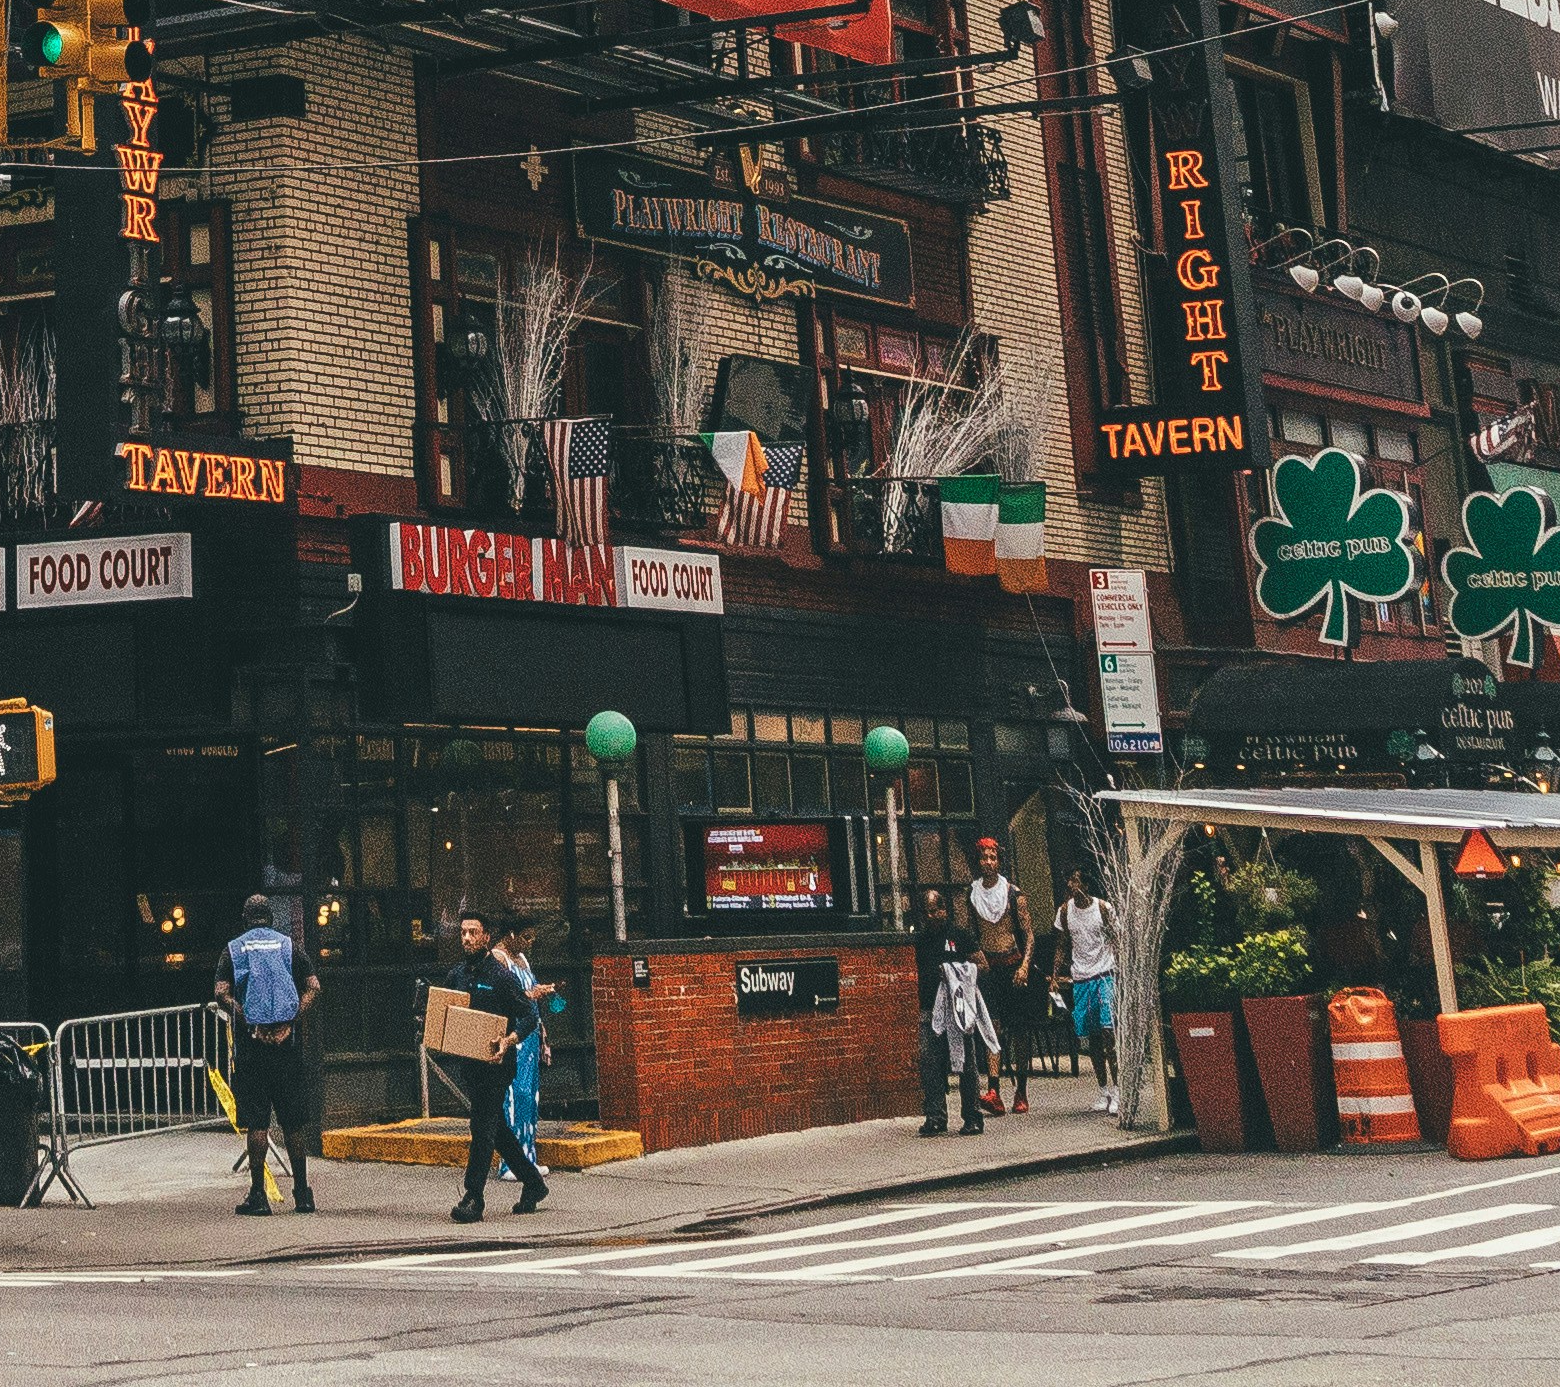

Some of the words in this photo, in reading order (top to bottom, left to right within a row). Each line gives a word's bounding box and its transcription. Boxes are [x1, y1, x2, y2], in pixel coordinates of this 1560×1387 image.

[612, 189, 743, 240] PLAYWRIGHT
[755, 204, 882, 290] RESTAURANT
[1101, 416, 1244, 460] TAVERN
[120, 442, 286, 503] TAVERN
[29, 551, 93, 596] FOOD
[100, 544, 172, 589] COURT
[398, 522, 535, 599] BURGER
[544, 538, 619, 608] MAN
[630, 555, 669, 600] FOOD
[674, 564, 714, 606] COURT
[1095, 572, 1105, 588] 3
[1096, 594, 1137, 602] COMMERCIAL
[1097, 603, 1126, 611] VEHICLES
[1127, 603, 1143, 611] ONLY
[1104, 657, 1114, 671] 6
[740, 966, 795, 996] Subway
